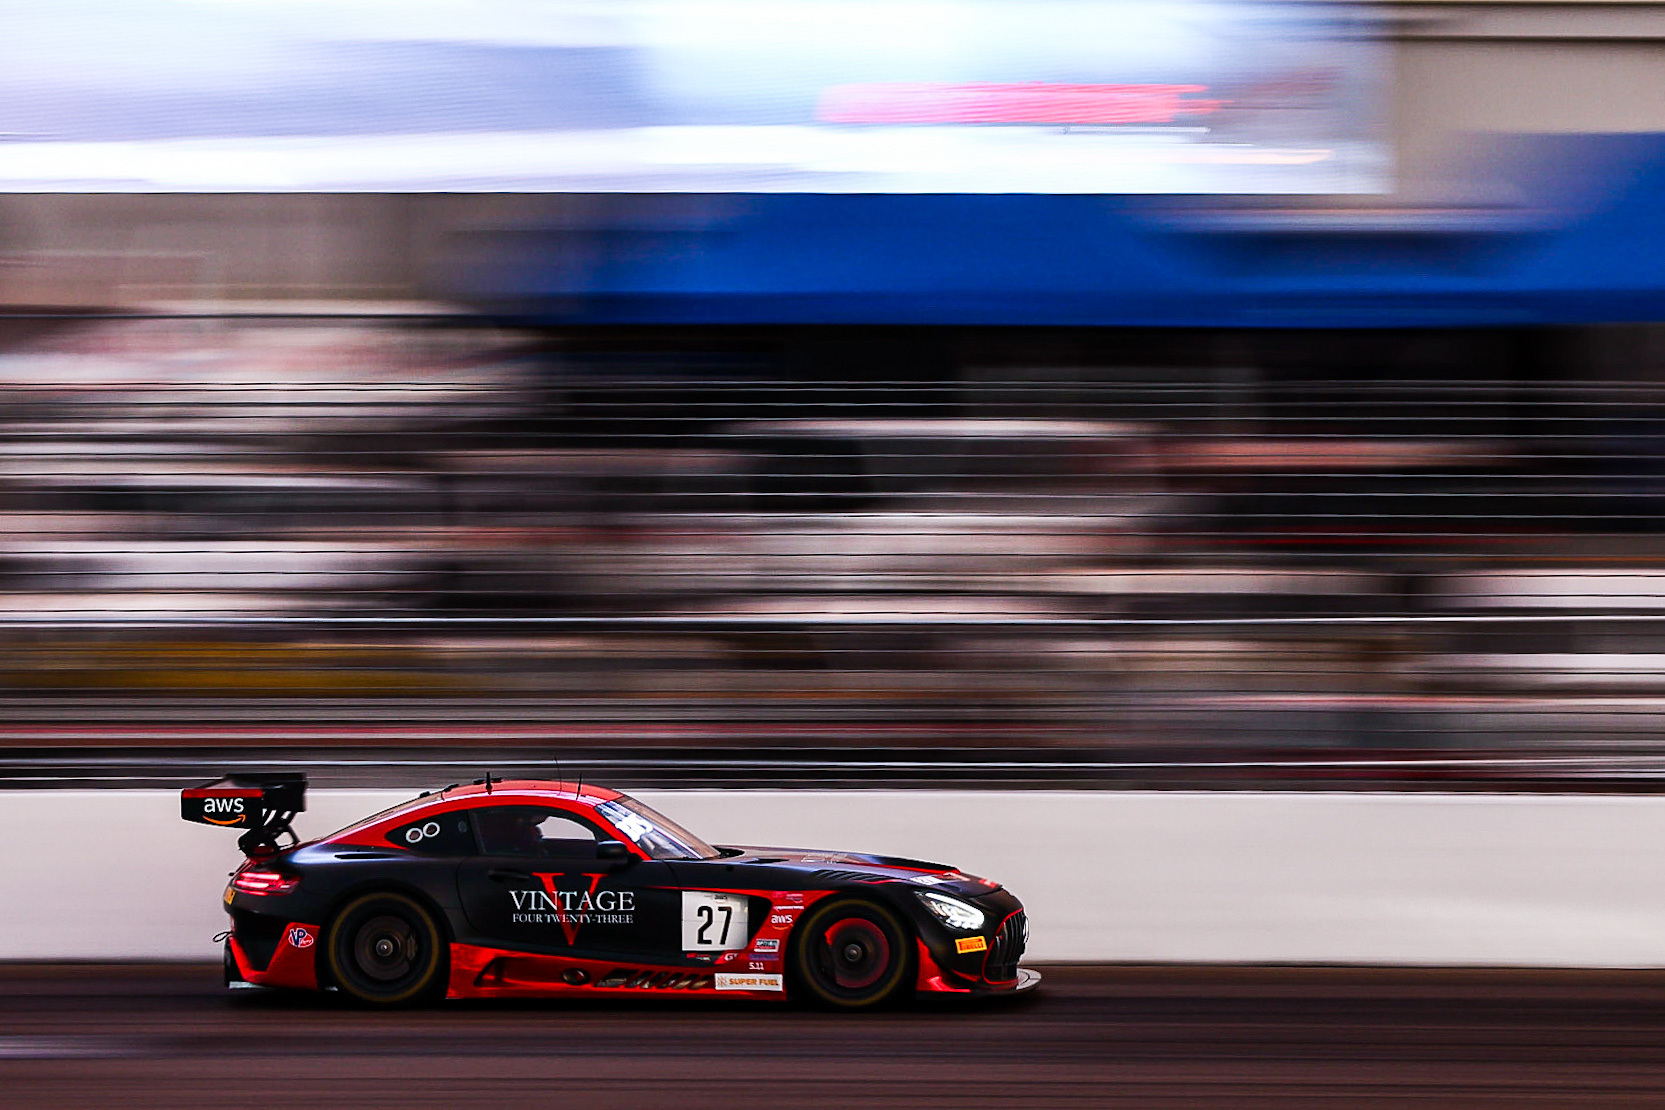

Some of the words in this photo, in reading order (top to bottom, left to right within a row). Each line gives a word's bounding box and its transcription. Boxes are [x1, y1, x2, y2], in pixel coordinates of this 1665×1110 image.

[203, 797, 245, 813] aws
[508, 890, 636, 911] VINTAGE
[512, 913, 543, 923] FOUR
[544, 913, 634, 924] TWENTY-THREE
[697, 905, 733, 945] 27
[771, 914, 793, 924] aws
[729, 977, 757, 986] SUPER
[759, 978, 779, 987] FUEL
